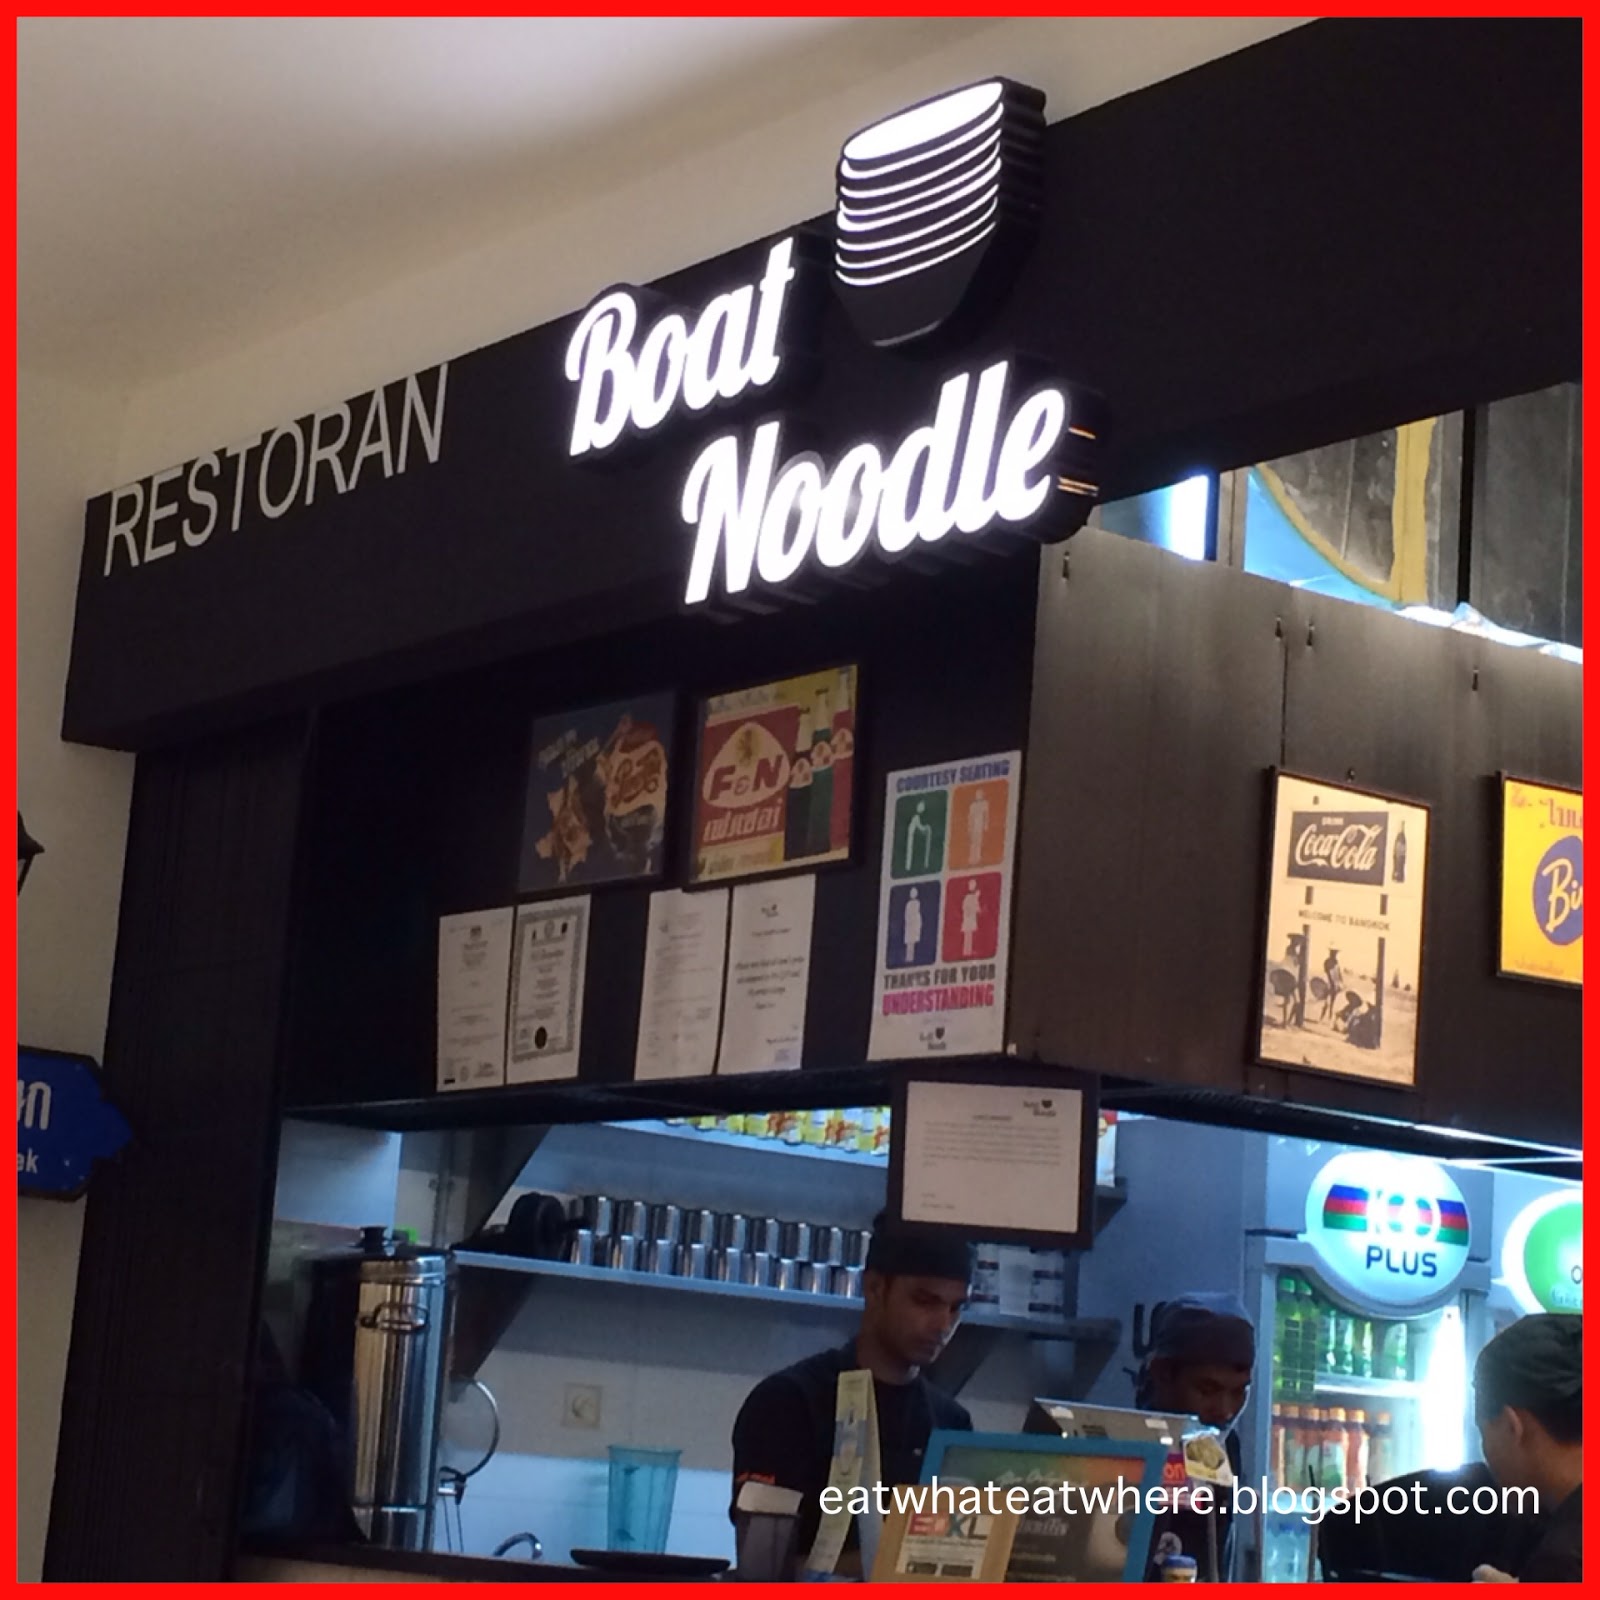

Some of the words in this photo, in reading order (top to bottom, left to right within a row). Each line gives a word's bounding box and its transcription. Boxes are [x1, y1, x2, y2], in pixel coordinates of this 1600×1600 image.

[566, 237, 795, 456] Boat
[103, 363, 450, 576] RESTORAN
[681, 361, 1065, 605] Noodle
[882, 984, 995, 1017] UNDERSTANDING
[883, 970, 931, 990] THANKS
[934, 966, 957, 985] FOR
[961, 963, 996, 983] YOUR
[1365, 1245, 1438, 1278] PLUS
